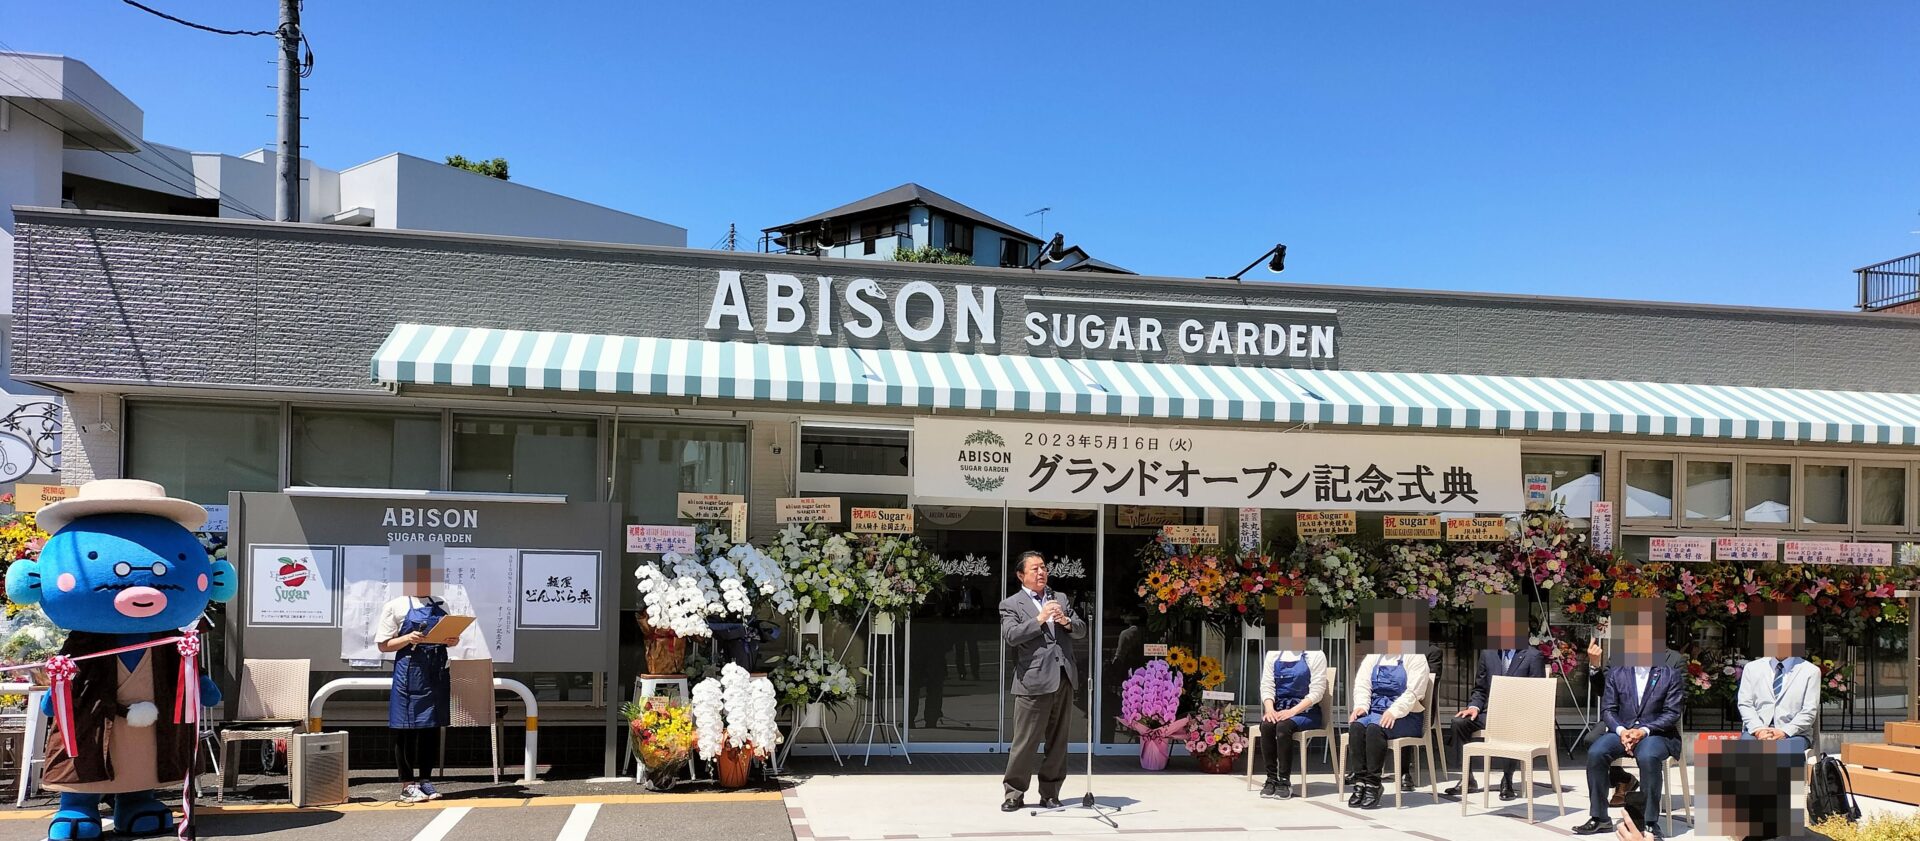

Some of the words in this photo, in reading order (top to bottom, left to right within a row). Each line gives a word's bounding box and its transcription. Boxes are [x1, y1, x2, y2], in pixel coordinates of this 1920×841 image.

[704, 270, 999, 345] ABISON
[1023, 311, 1164, 352] SUGAR
[1178, 318, 1335, 359] GARDEN
[957, 449, 1012, 465] ABISON
[960, 464, 982, 472] SUGAR
[983, 465, 1010, 473] GARDEN
[1027, 453, 1480, 505] グランドオープン記念式典
[42, 486, 66, 495] 祝開店
[382, 507, 479, 529] ABISON
[878, 509, 905, 523] Sugar
[1319, 511, 1343, 521] Sugar
[1384, 516, 1397, 528] 祝
[1399, 517, 1429, 528] sugar
[1471, 518, 1497, 528] Sugar
[387, 532, 425, 542] SUGAR
[428, 533, 472, 543] GARDEN
[1164, 526, 1174, 535] 祝
[546, 575, 573, 589] 麺屋
[274, 586, 310, 603] Sugar
[525, 588, 593, 605] どんぶら来
